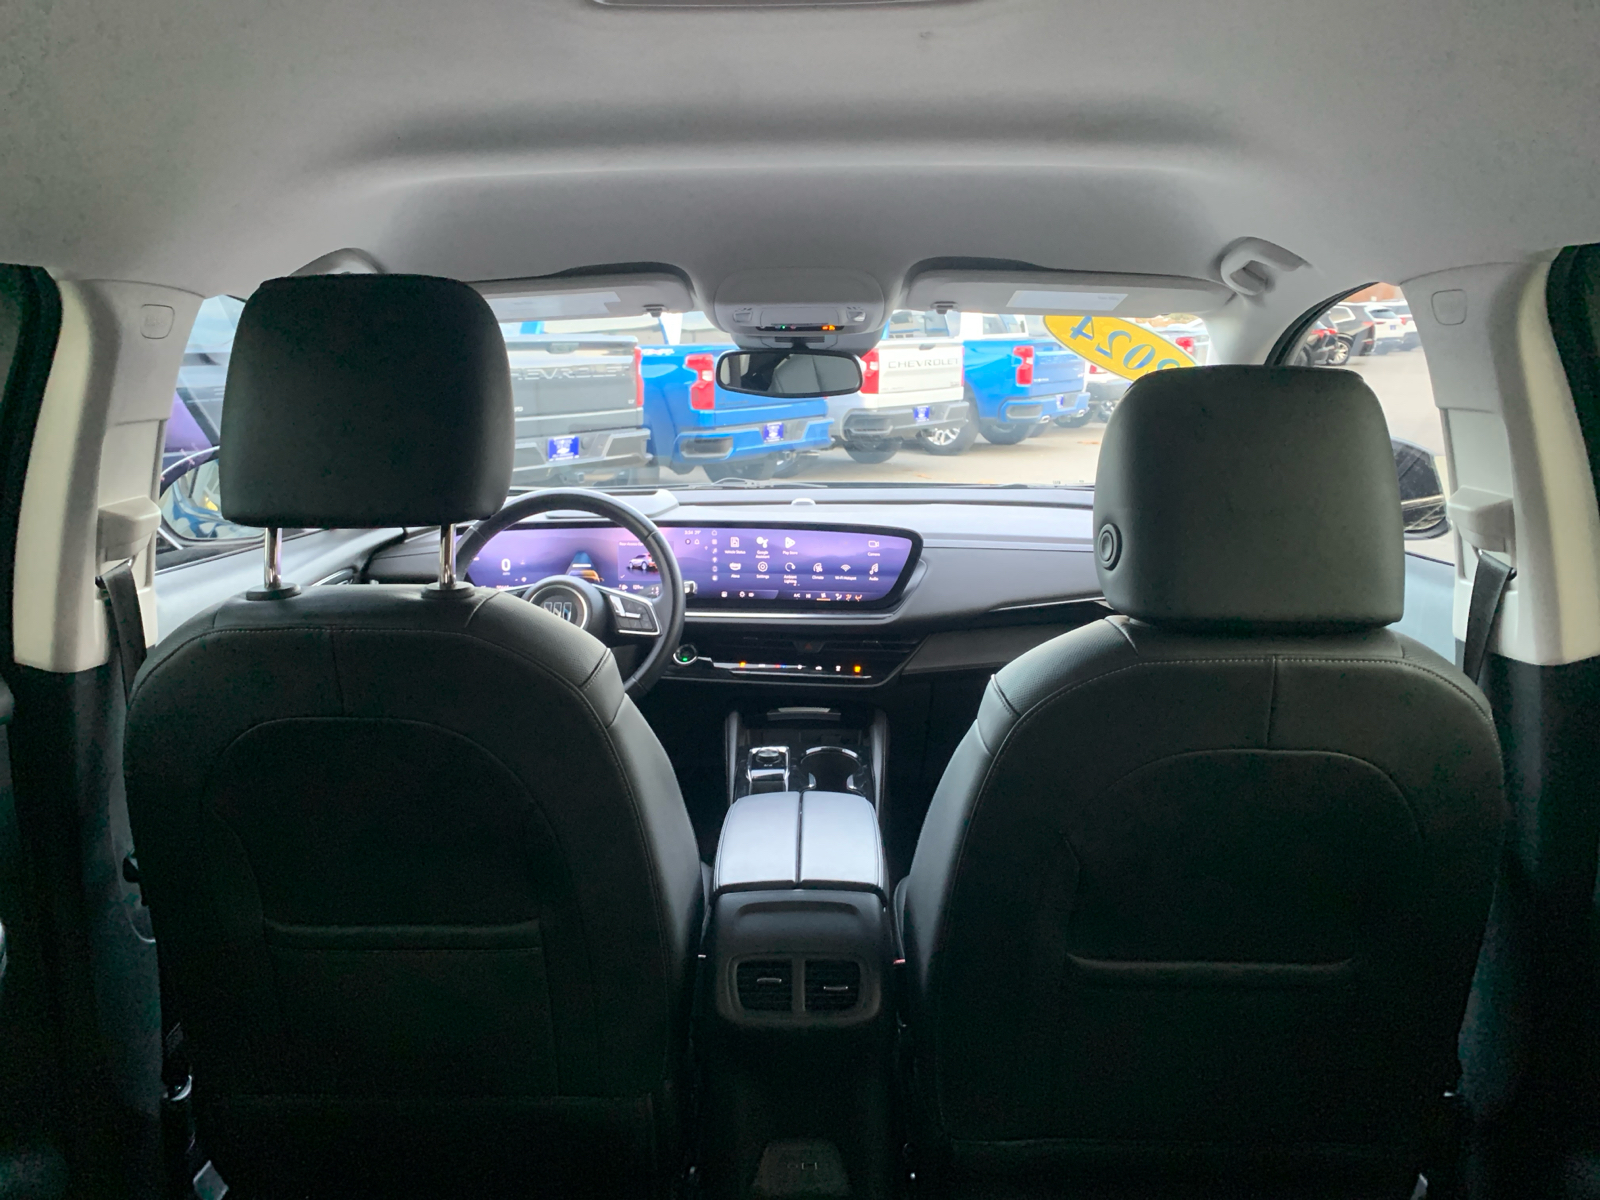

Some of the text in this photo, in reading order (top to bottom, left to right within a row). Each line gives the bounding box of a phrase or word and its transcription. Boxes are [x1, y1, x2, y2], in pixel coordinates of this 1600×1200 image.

[888, 358, 959, 369] CHEVROLET
[510, 365, 630, 381] HEVROLET
[501, 558, 511, 571] 0
